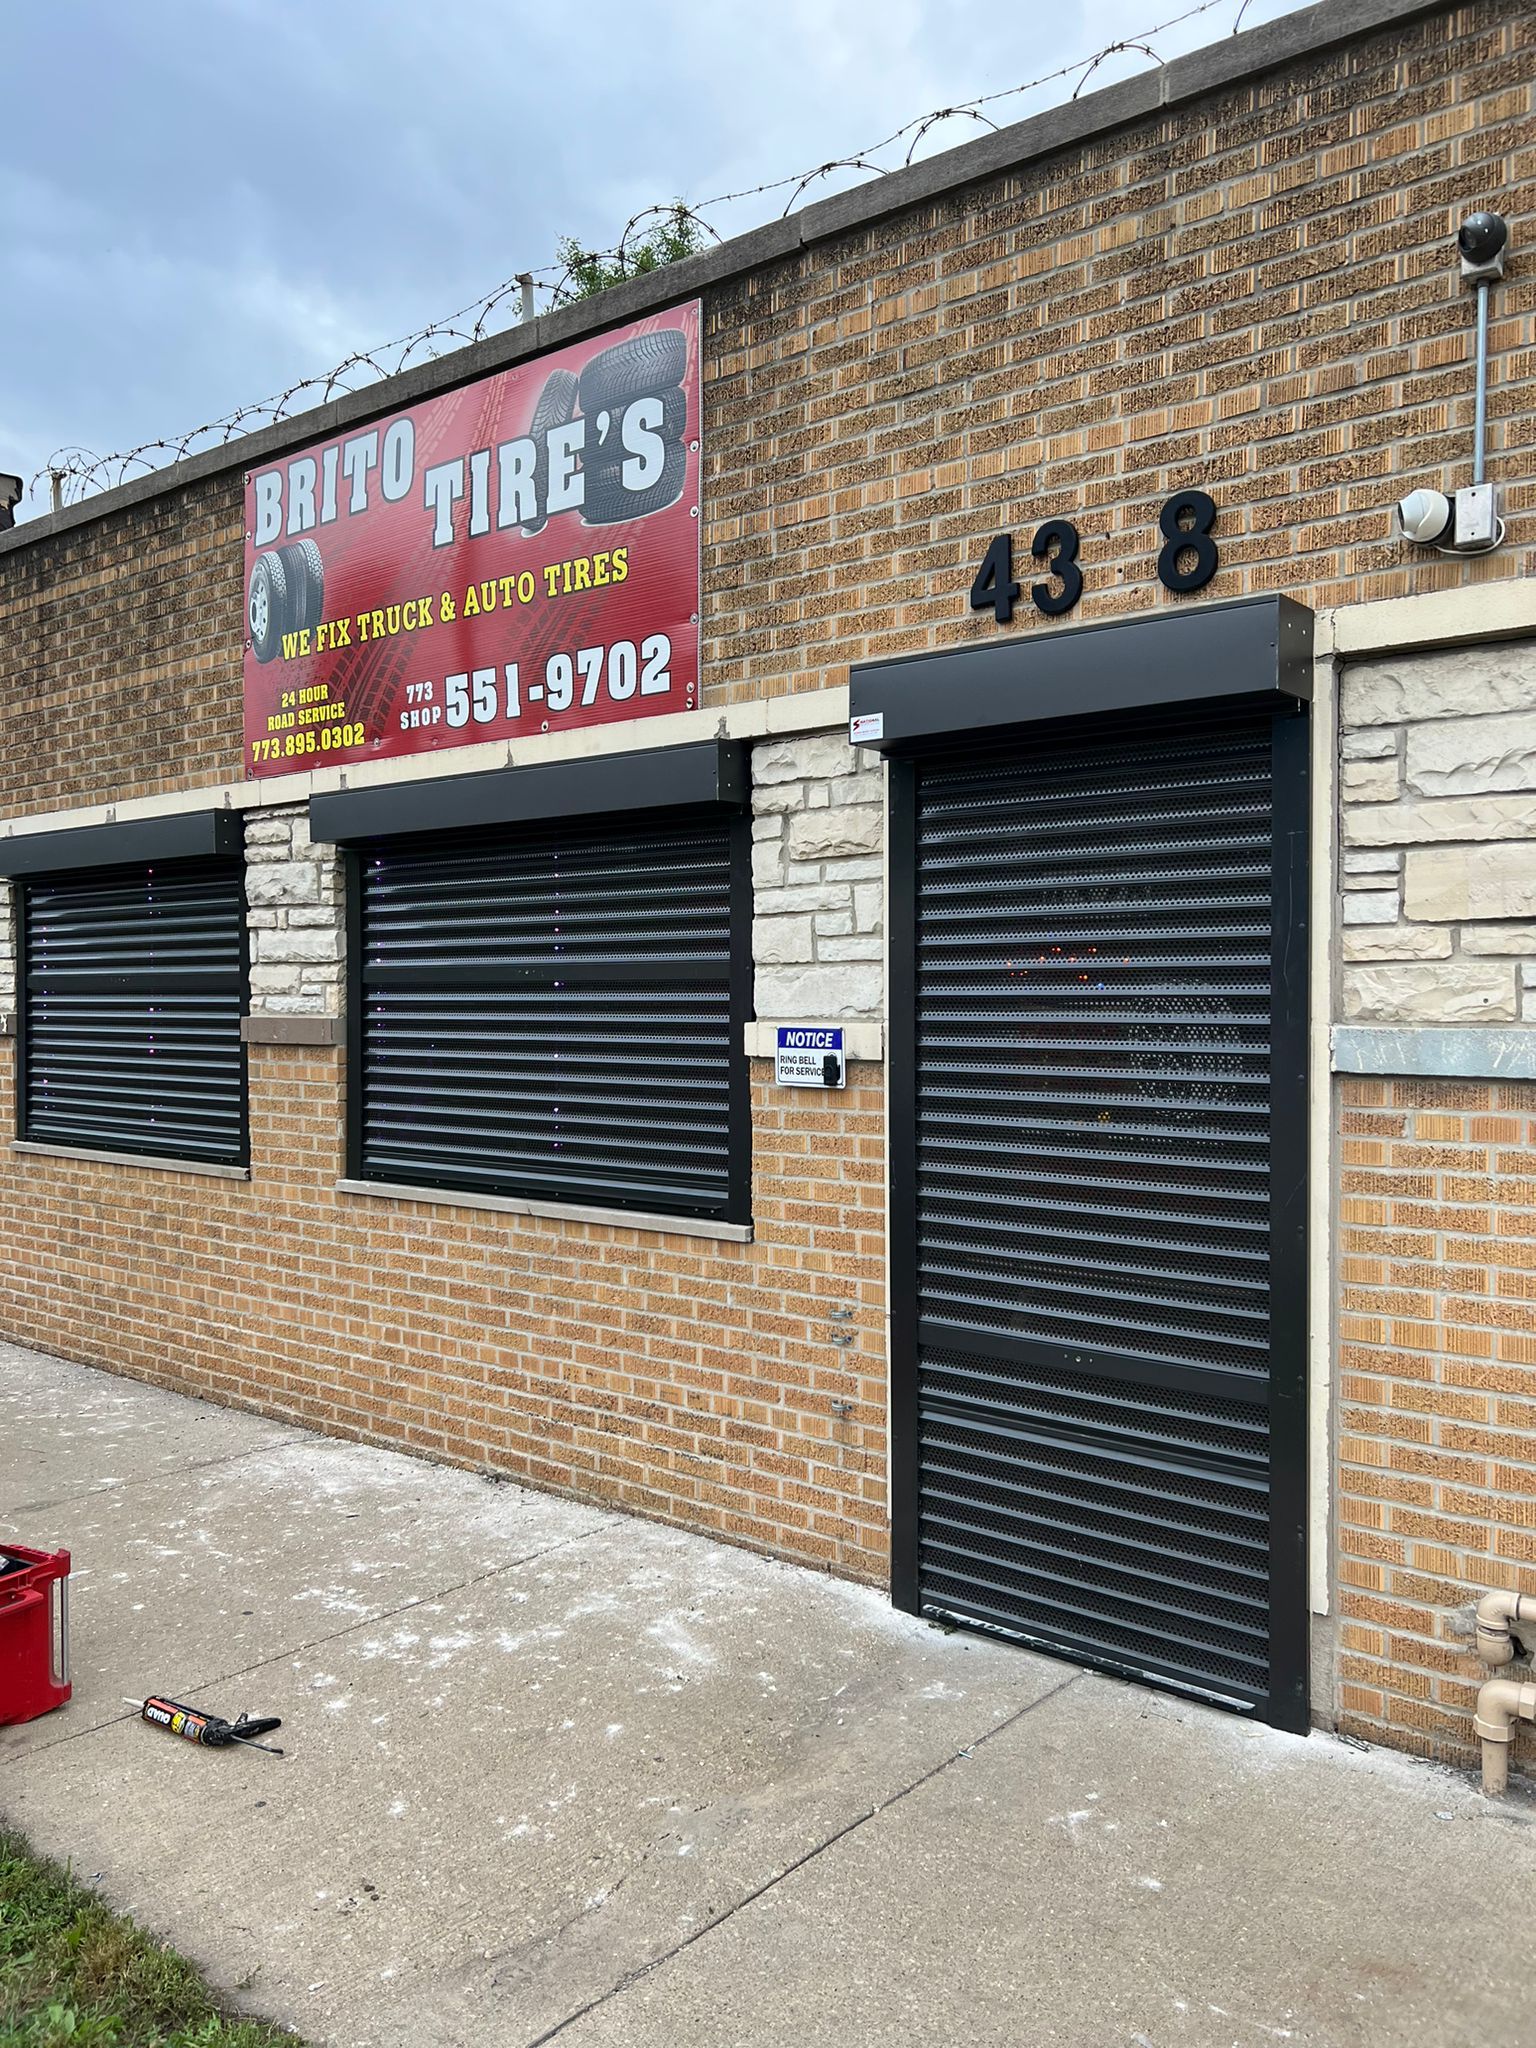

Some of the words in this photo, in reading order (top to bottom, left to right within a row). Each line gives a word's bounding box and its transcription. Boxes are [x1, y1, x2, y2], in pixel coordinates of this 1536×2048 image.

[254, 418, 415, 547] BRITO
[424, 398, 665, 547] TIRE'S
[282, 629, 311, 660] WE
[316, 622, 351, 652] FIX
[357, 596, 432, 642] TRUCK
[440, 592, 457, 622] &
[464, 571, 535, 617] AUTO
[544, 547, 630, 597] TIRES
[400, 707, 441, 730] SHOP
[445, 634, 672, 728] 551-9702
[406, 682, 433, 703] 773
[281, 692, 295, 708] 24
[299, 685, 328, 703] HOUR
[267, 712, 295, 731] ROAD
[299, 702, 345, 725] SERVICE
[252, 723, 365, 761] 773.895.0302
[786, 1032, 833, 1047] NOTICE
[780, 1056, 797, 1064] RING
[799, 1056, 816, 1065] BELL
[780, 1066, 795, 1075] FOR
